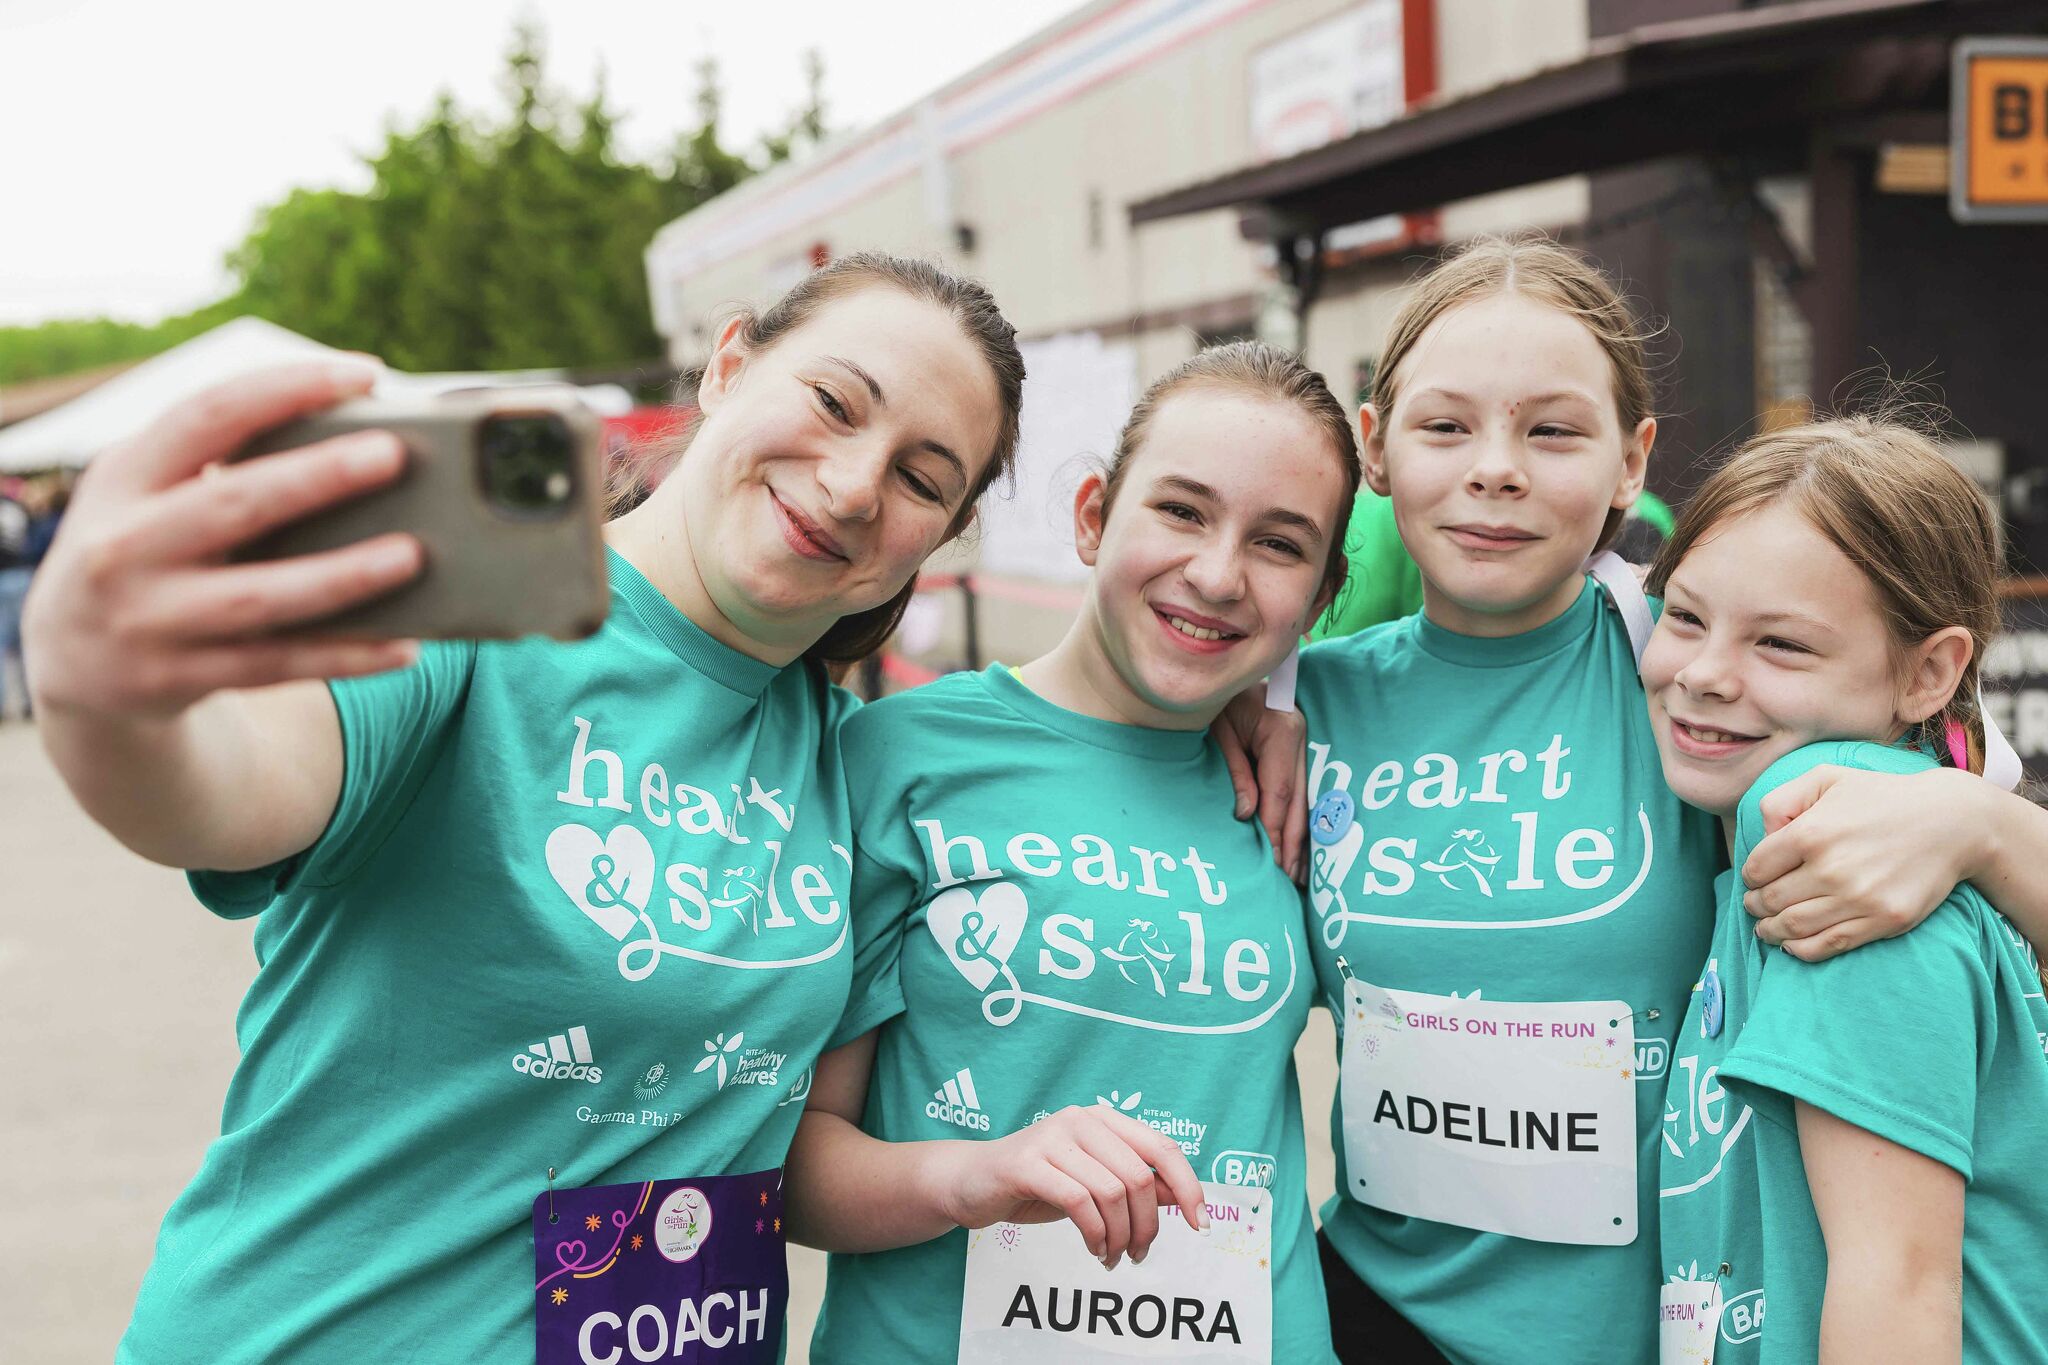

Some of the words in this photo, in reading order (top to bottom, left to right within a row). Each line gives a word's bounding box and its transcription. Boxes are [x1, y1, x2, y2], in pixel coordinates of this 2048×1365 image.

[557, 716, 794, 844] heart
[1308, 734, 1572, 810] heart
[915, 820, 1228, 905] heart
[1406, 1012, 1459, 1032] GIRLS
[1465, 1019, 1497, 1036] ON
[1504, 1022, 1543, 1038] THE
[1551, 1023, 1596, 1038] RUN
[512, 1053, 603, 1084] adidas
[737, 1050, 788, 1073] healthy
[1634, 1047, 1664, 1072] ND
[576, 1105, 636, 1124] Gamma
[640, 1110, 669, 1127] Phi
[925, 1100, 991, 1132] adidas
[1143, 1108, 1159, 1117] RITE
[1160, 1110, 1172, 1118] AID
[1372, 1089, 1600, 1152] ADELINE
[1205, 1204, 1239, 1222] RUN
[578, 1288, 768, 1365] COACH
[1002, 1284, 1242, 1344] AURORA
[1677, 1304, 1695, 1320] RUN
